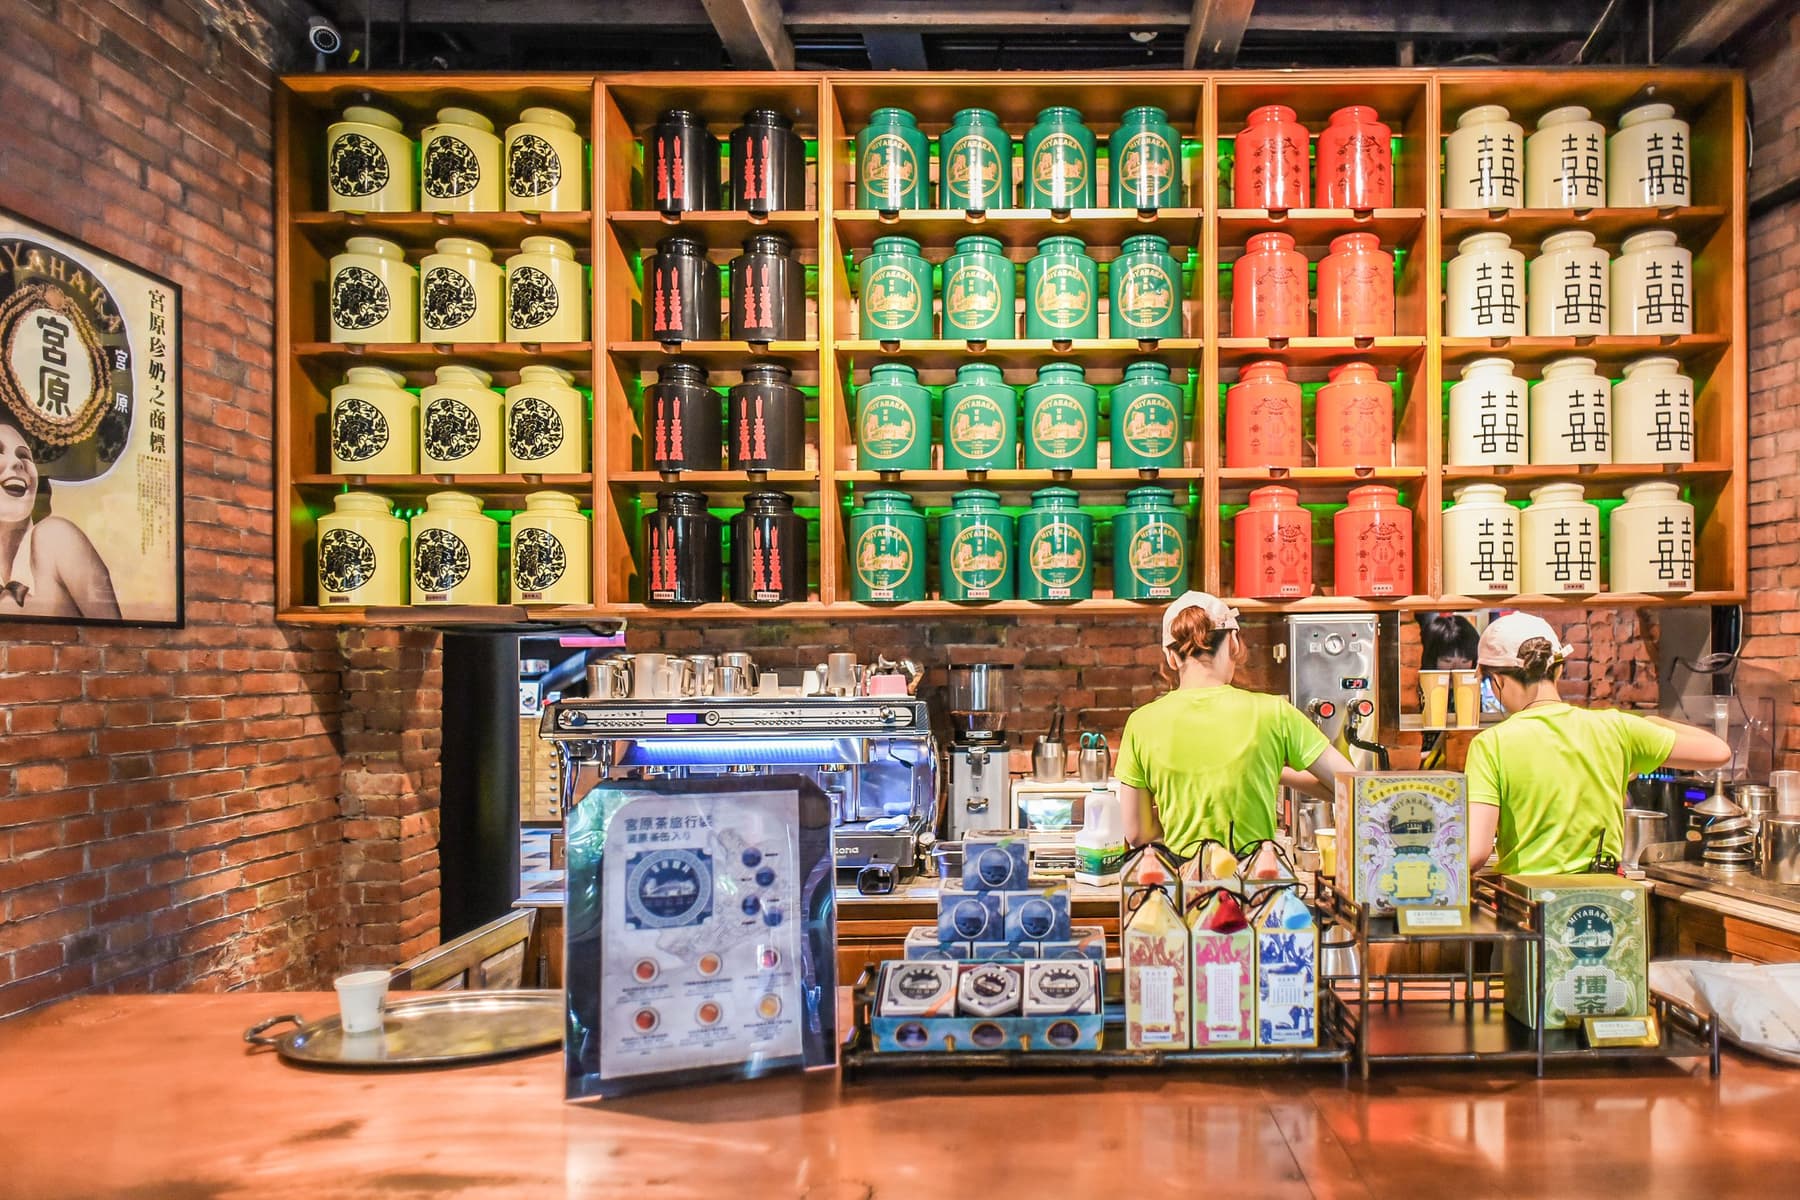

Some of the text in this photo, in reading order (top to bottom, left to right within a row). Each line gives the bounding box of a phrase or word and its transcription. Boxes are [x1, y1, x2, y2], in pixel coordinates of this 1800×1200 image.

[37, 316, 71, 416] 宮原
[148, 289, 166, 454] 宮原珍奶之商標
[1569, 910, 1610, 925] MIYAHARA
[1574, 975, 1608, 1015] 擂茶
